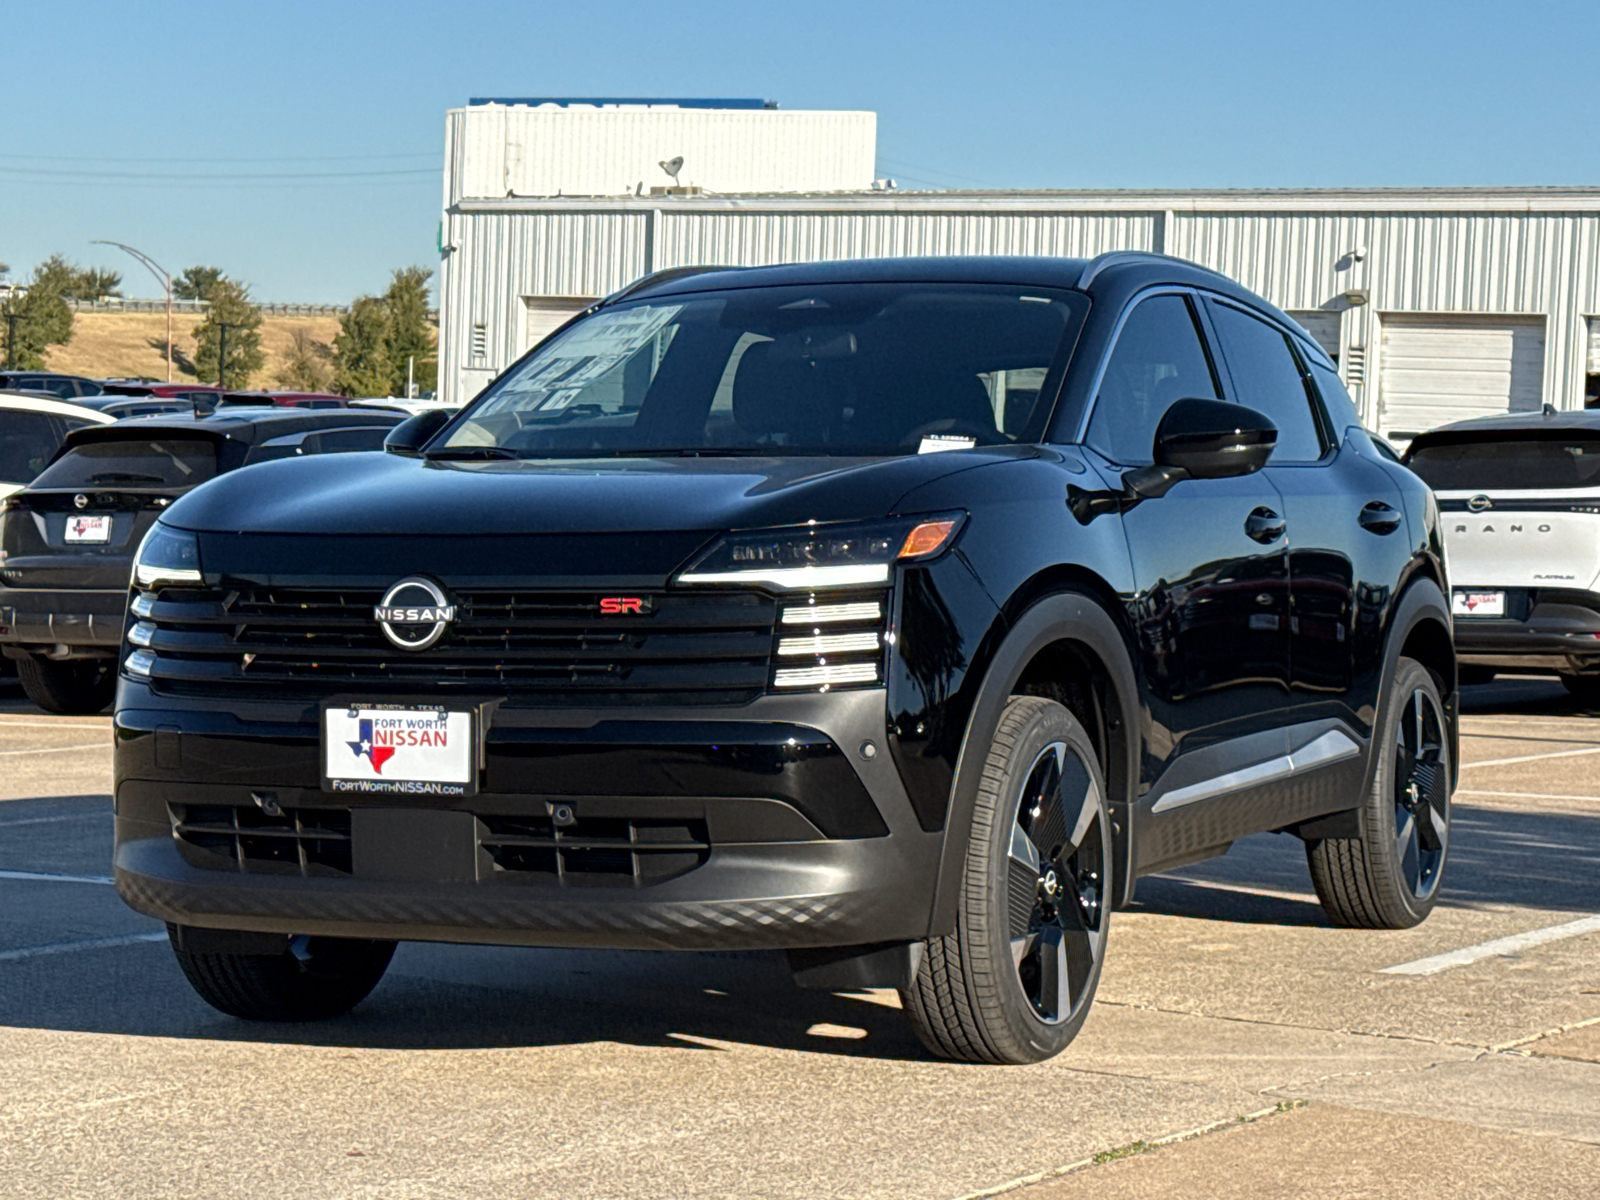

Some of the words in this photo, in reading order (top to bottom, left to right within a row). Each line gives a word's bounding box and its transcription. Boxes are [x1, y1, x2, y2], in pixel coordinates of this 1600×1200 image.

[1454, 524, 1551, 533] RANO
[600, 597, 643, 613] SR
[375, 607, 450, 621] NISSAN
[374, 718, 403, 729] FORT
[406, 719, 447, 730] WORTH
[375, 730, 447, 747] NISSAN
